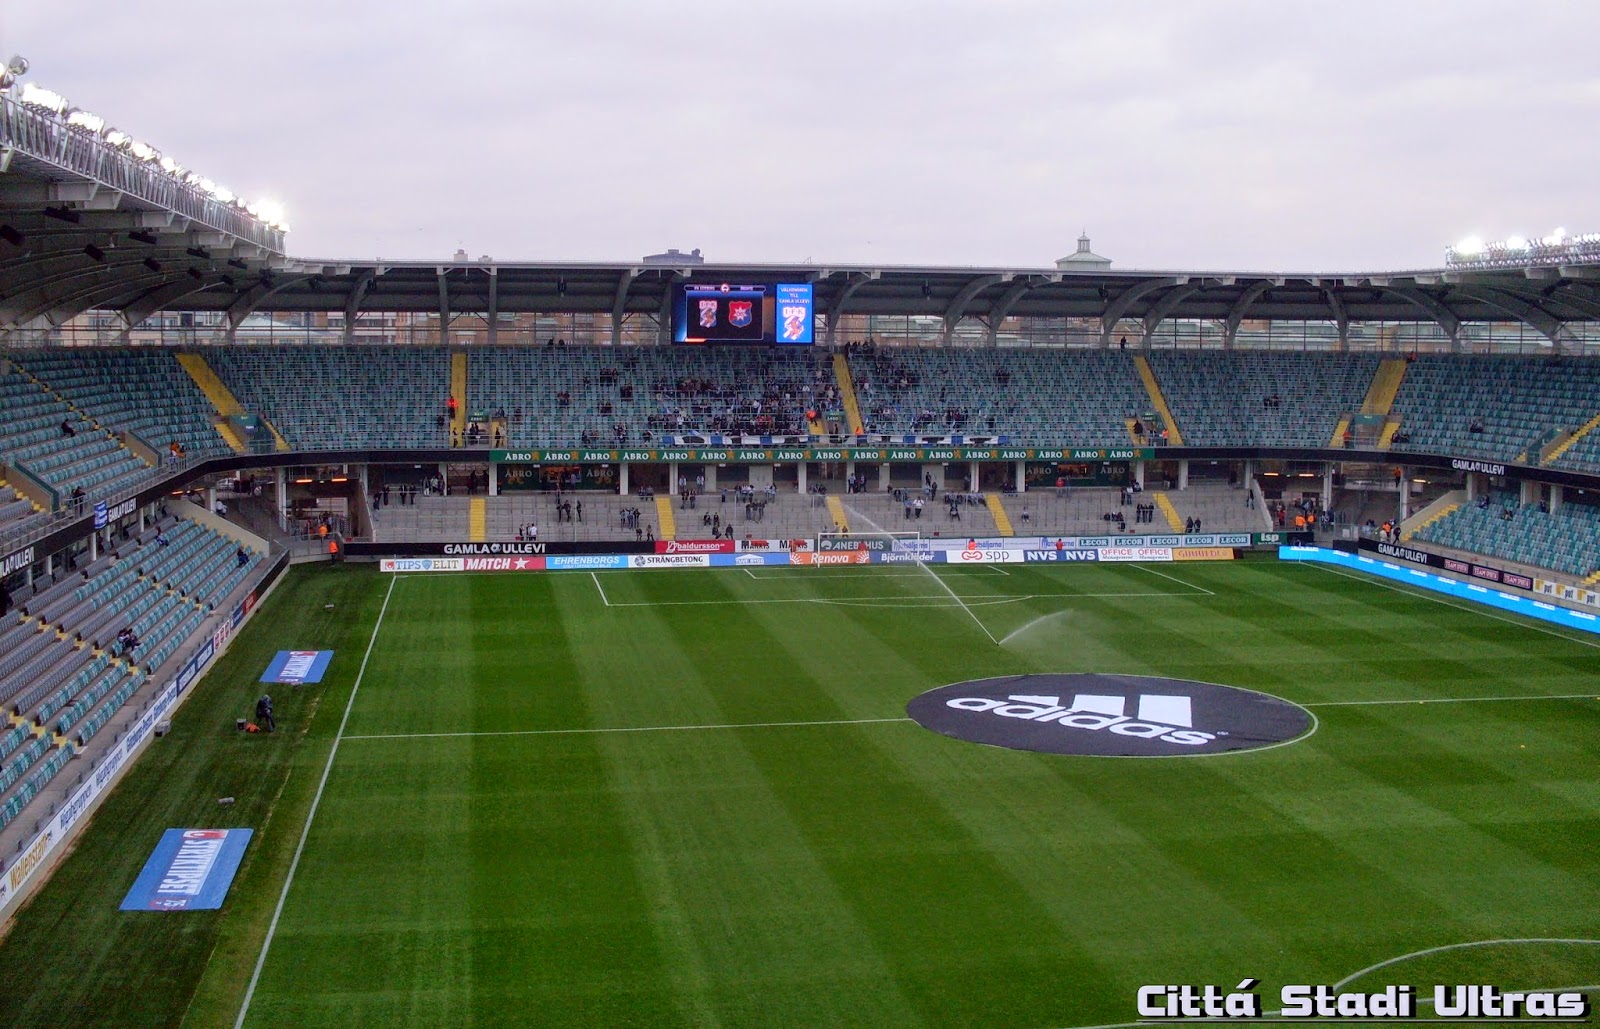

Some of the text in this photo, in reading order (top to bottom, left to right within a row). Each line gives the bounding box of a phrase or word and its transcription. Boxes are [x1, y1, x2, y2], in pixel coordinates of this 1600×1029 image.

[1452, 459, 1504, 475] GAMLA ULLEVI
[444, 544, 546, 554] GAMLA ULLEVI
[833, 541, 884, 550] ANEBHUS
[15, 546, 34, 569] ULLEVI
[810, 553, 849, 563] Renova
[1028, 551, 1057, 560] NVS
[1066, 551, 1098, 560] NVS
[1378, 544, 1427, 564] GAMLA ULLEVI
[396, 560, 459, 570] TIPS ELIT
[466, 558, 511, 570] MATCH
[554, 556, 620, 564] EHRENBORGS
[946, 697, 1216, 745] adidas
